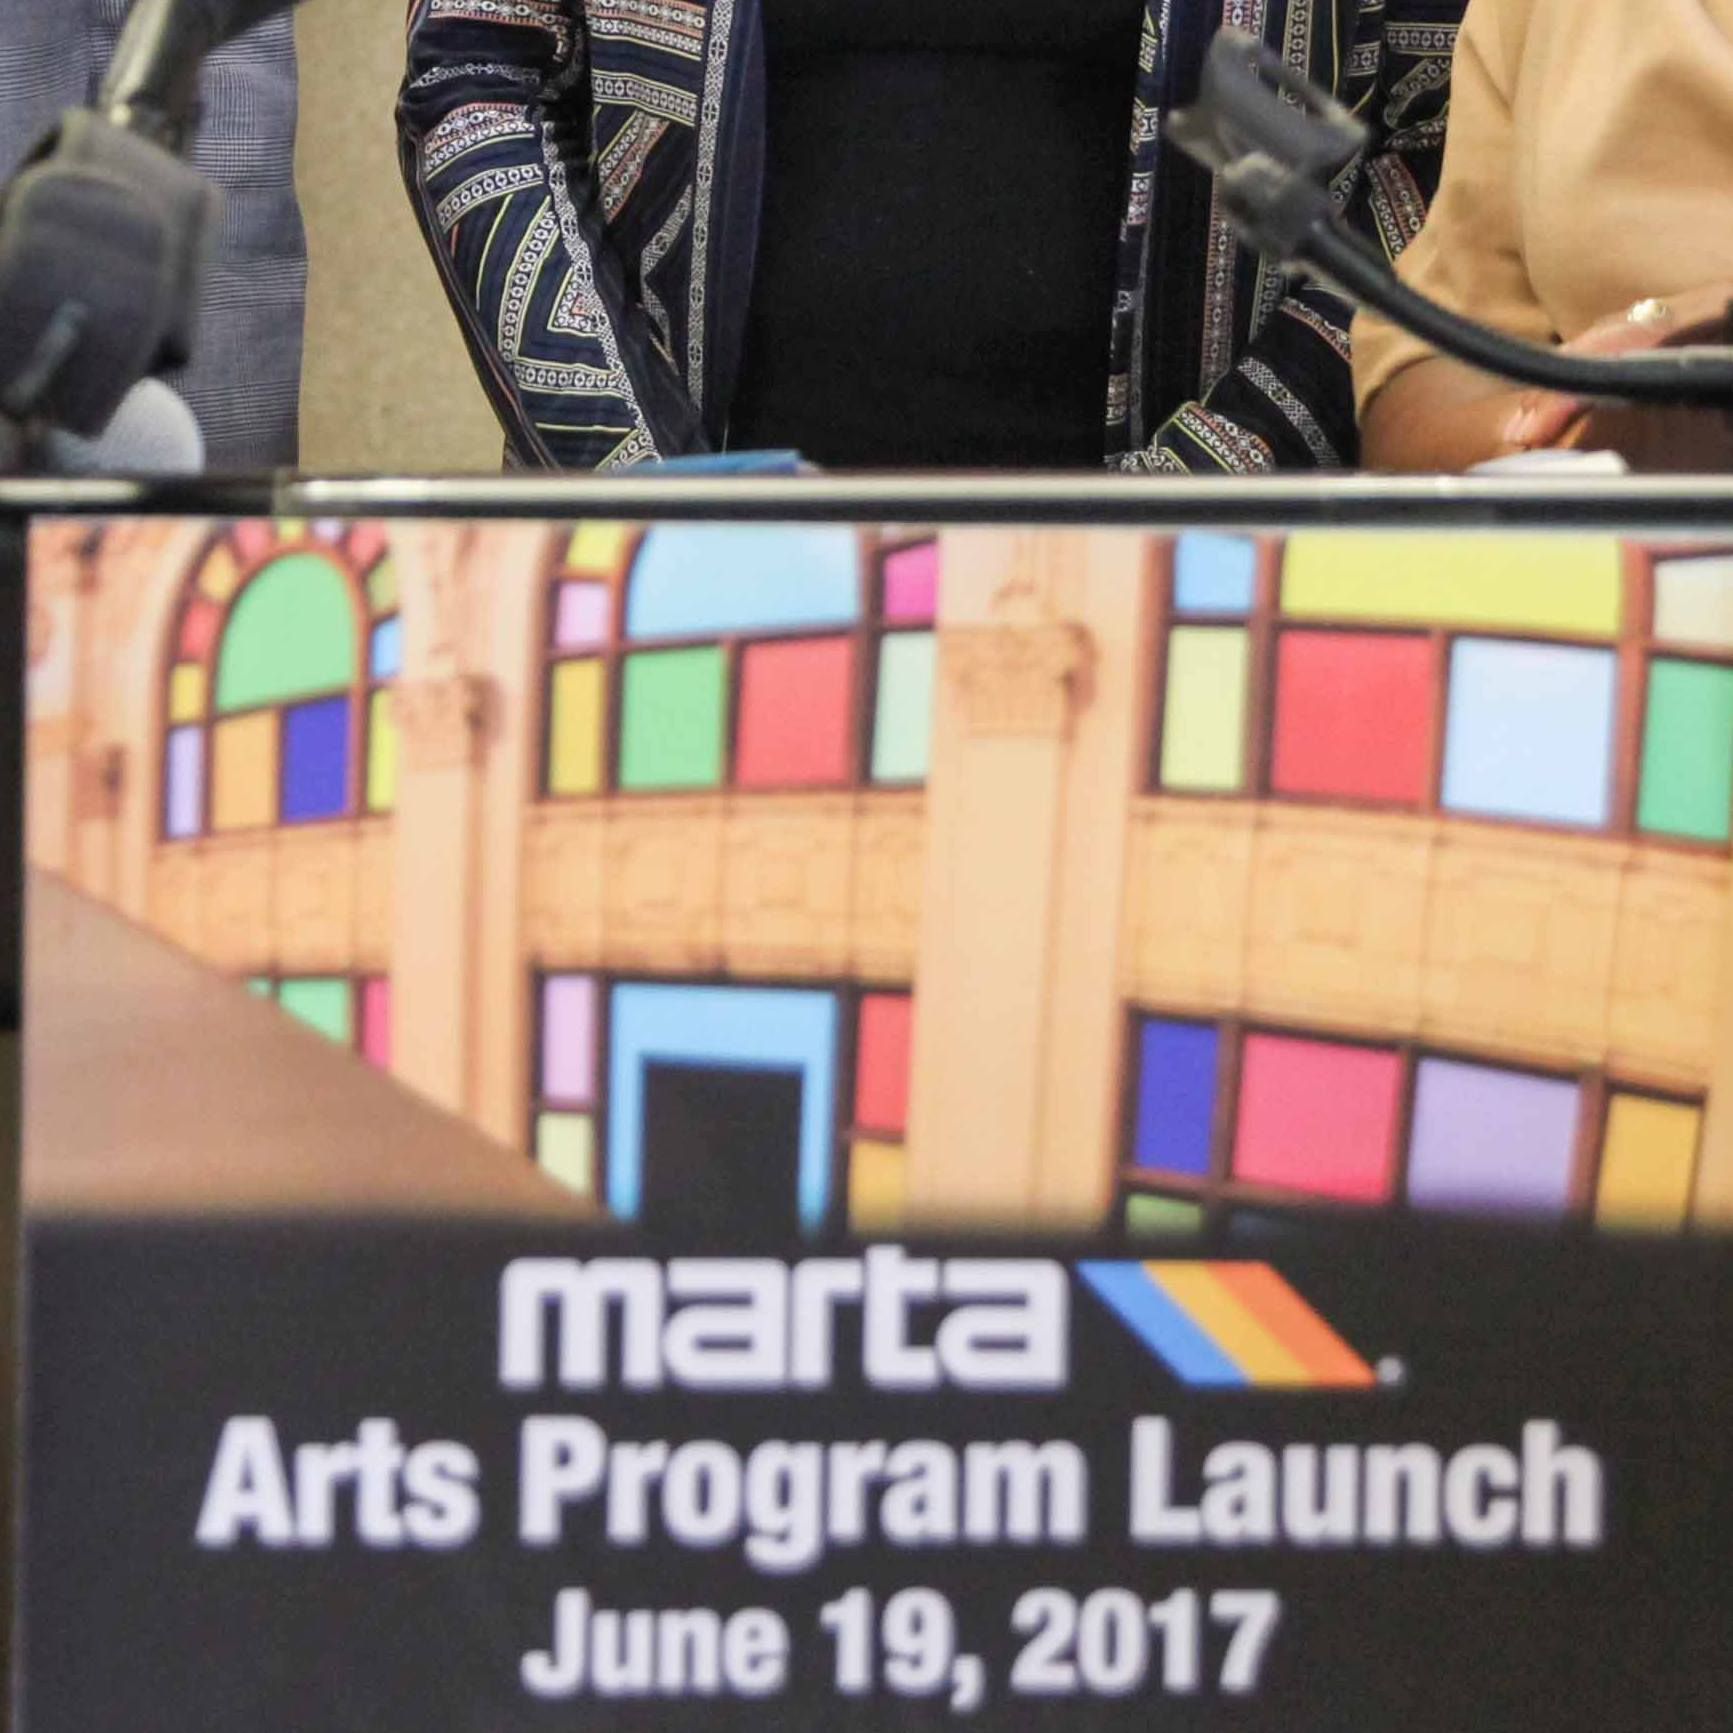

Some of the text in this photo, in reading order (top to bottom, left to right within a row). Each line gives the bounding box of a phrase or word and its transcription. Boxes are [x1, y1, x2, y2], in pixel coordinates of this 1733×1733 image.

[498, 1243, 1069, 1389] marta
[194, 1414, 1602, 1573] Arts Program Launch
[520, 1586, 1280, 1711] June 19, 2017
